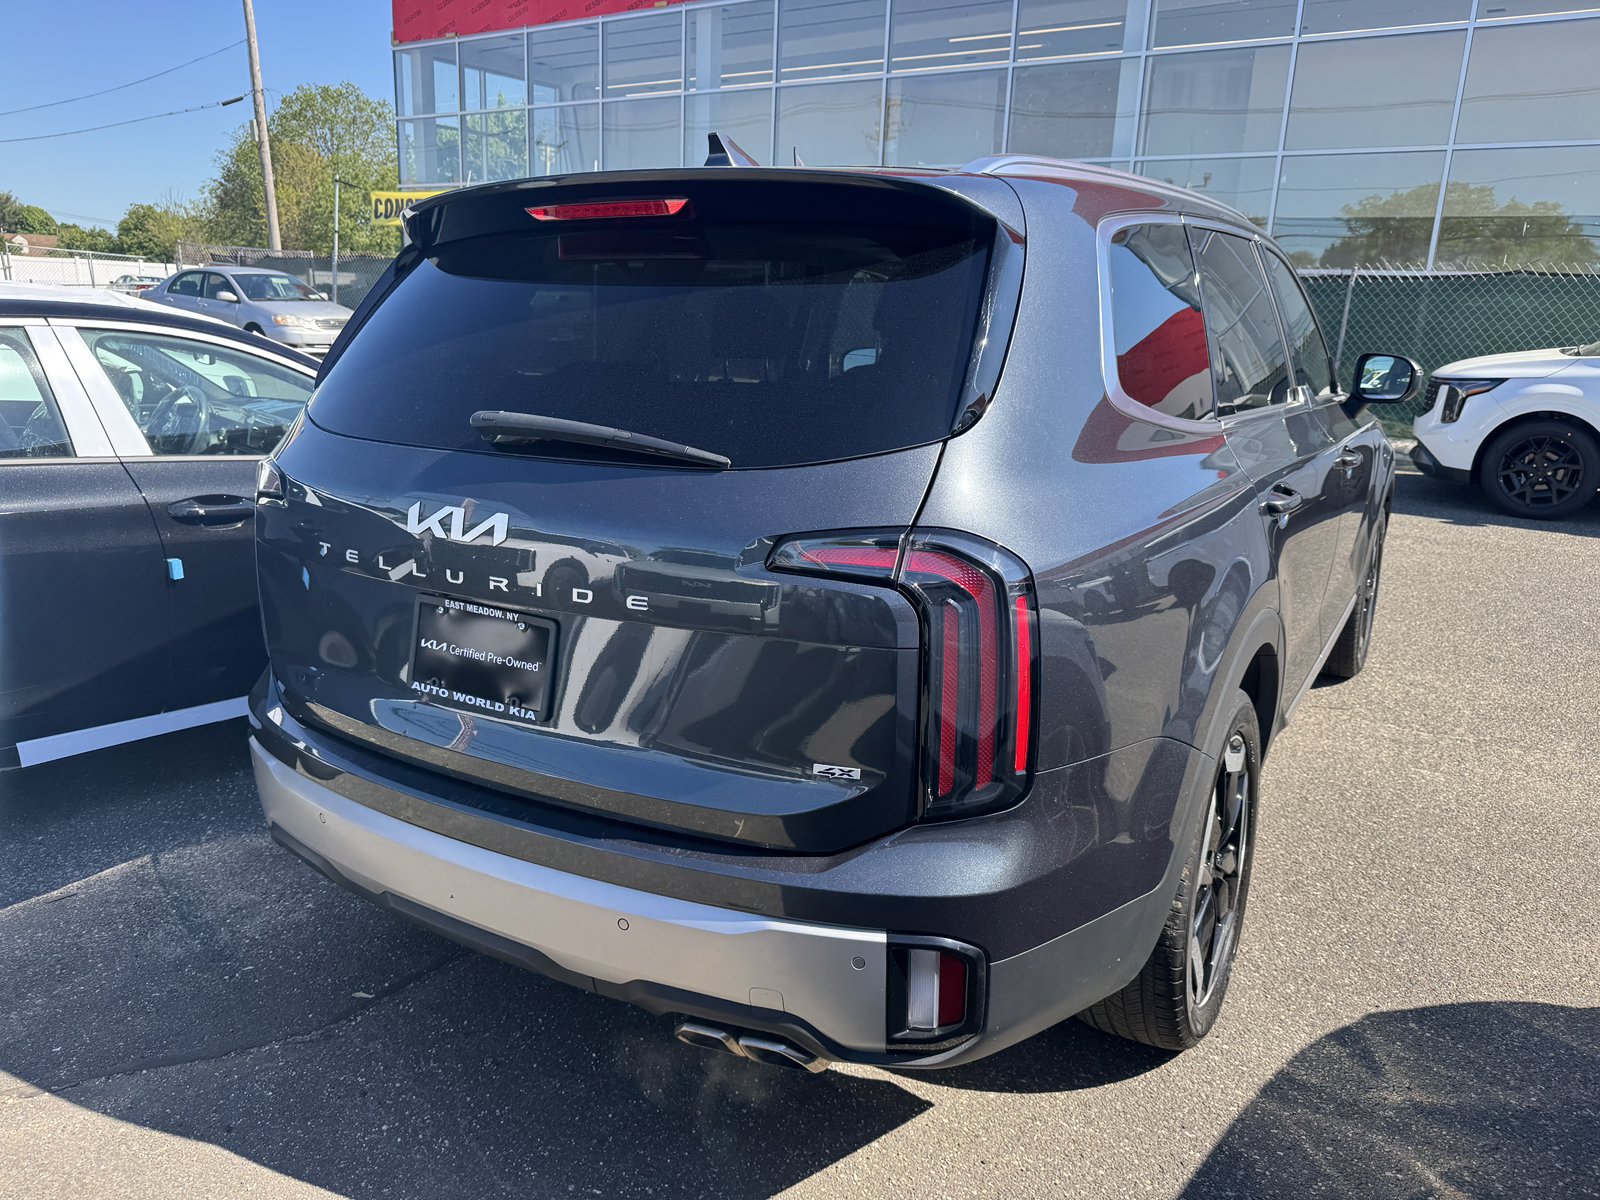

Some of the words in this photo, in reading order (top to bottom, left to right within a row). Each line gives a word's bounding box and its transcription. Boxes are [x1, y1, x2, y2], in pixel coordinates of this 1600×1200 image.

[403, 9, 422, 24] RESISTO
[436, 0, 455, 11] ESISTO
[407, 501, 509, 547] KIA
[319, 541, 649, 611] TELLURIDE
[444, 599, 465, 611] EAST
[506, 611, 519, 622] NY
[421, 638, 447, 652] KIA
[449, 644, 486, 661] Certified
[411, 681, 449, 698] AUTO
[453, 691, 505, 712] WORLD
[509, 705, 536, 721] KIA
